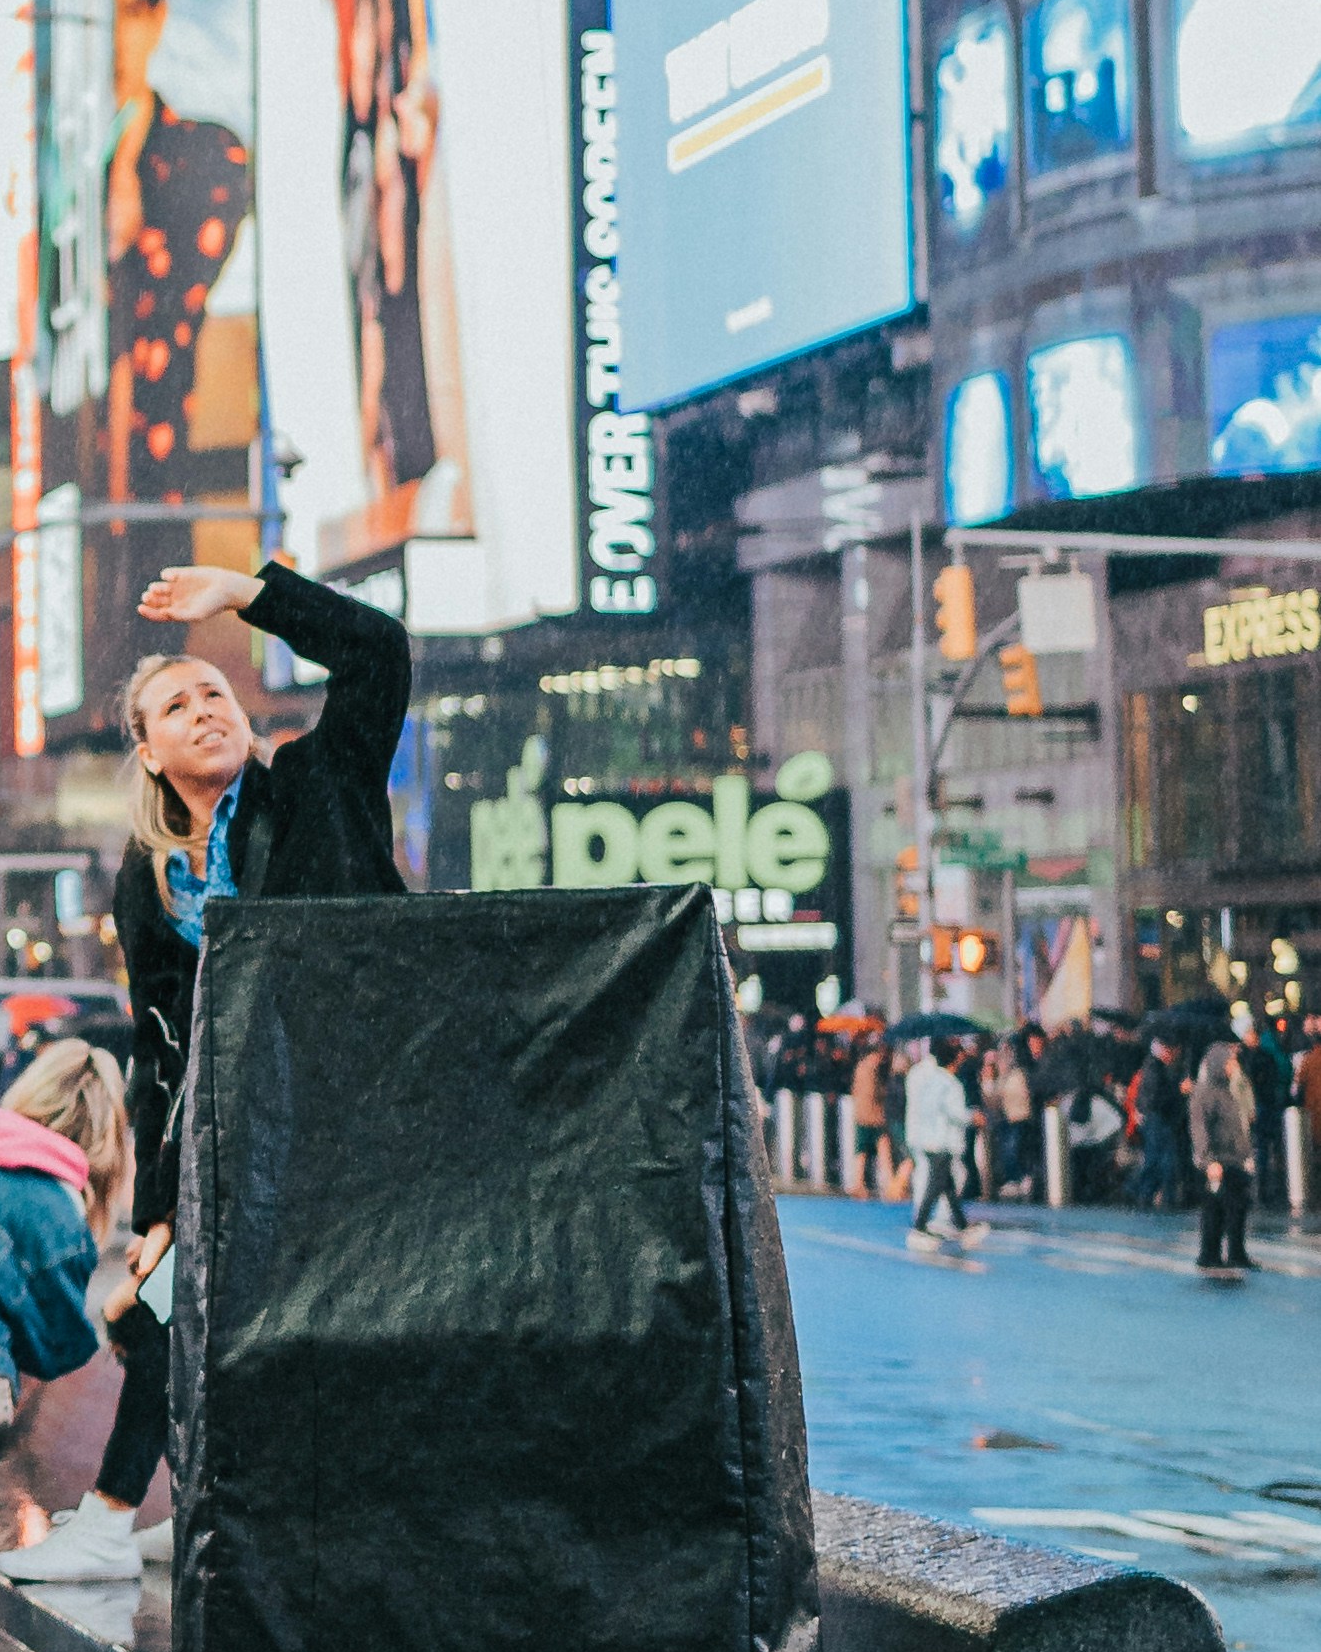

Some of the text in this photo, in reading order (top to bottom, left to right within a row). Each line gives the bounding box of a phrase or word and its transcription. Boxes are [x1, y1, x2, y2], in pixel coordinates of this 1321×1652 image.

[586, 411, 656, 569] OVER
[1203, 588, 1321, 666] EXPRESS
[551, 750, 833, 895] pelé
